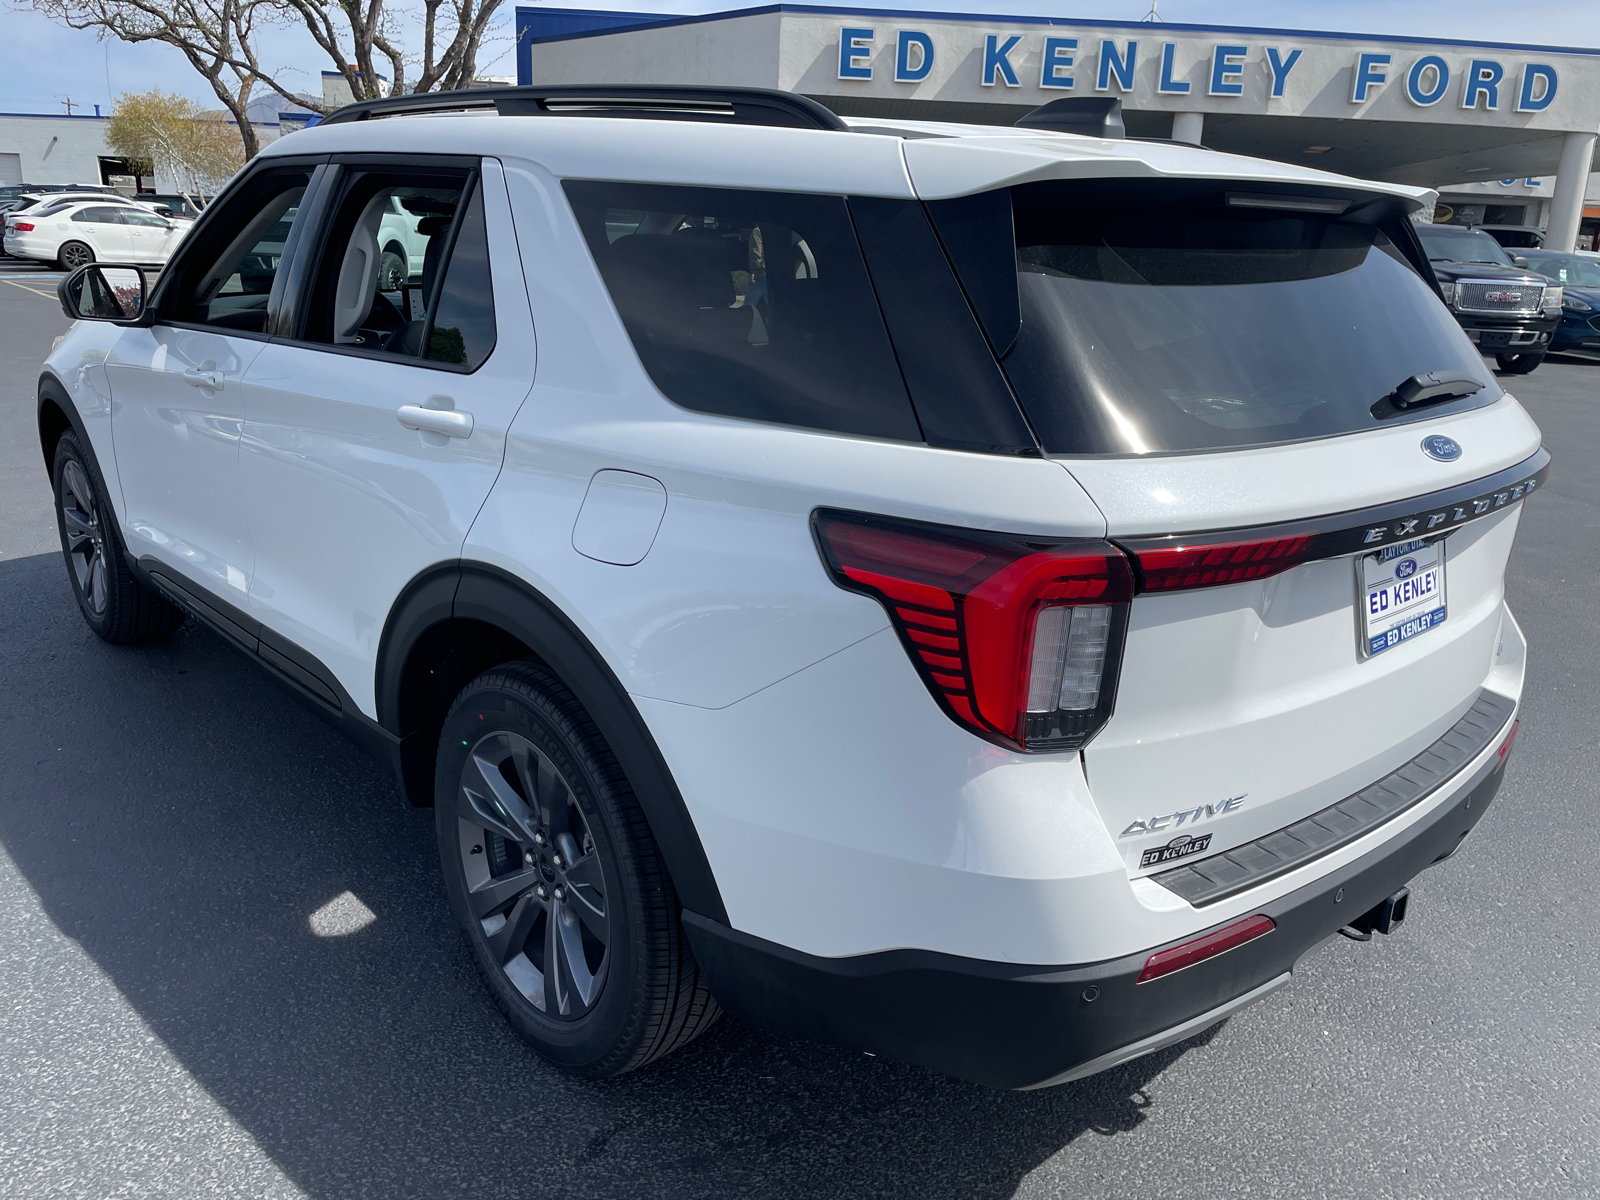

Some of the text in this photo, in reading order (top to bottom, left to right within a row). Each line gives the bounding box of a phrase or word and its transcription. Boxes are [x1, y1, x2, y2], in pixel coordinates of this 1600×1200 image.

[838, 27, 1559, 114] ED KENLEY FORD
[1486, 291, 1522, 303] GMC
[1432, 438, 1457, 455] Ford
[1363, 479, 1537, 544] EXPLORER
[1399, 562, 1414, 578] Ford
[1369, 569, 1438, 615] ED KENLEY
[1387, 630, 1400, 647] ED
[1401, 614, 1432, 640] KENLEY
[531, 722, 592, 812] MICHELIN
[1119, 793, 1249, 837] ACTIVE
[1142, 838, 1211, 865] ED KENLEY
